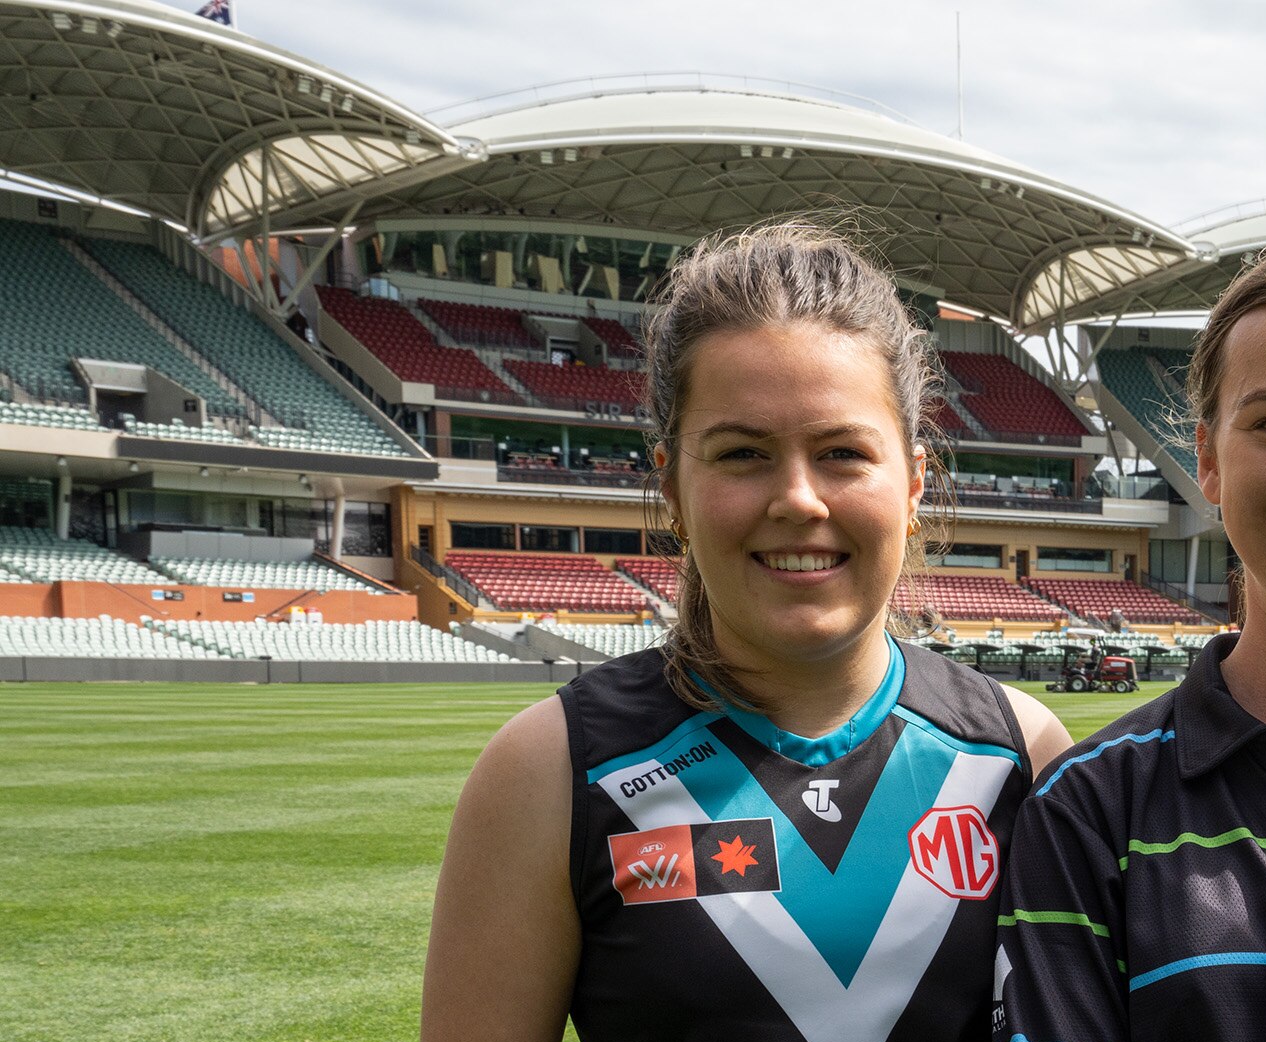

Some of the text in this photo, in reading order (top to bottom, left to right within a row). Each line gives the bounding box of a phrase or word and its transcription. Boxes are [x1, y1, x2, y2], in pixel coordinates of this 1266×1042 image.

[620, 742, 718, 798] COTTON:ON
[640, 842, 663, 855] AFL
[917, 812, 995, 892] MG
